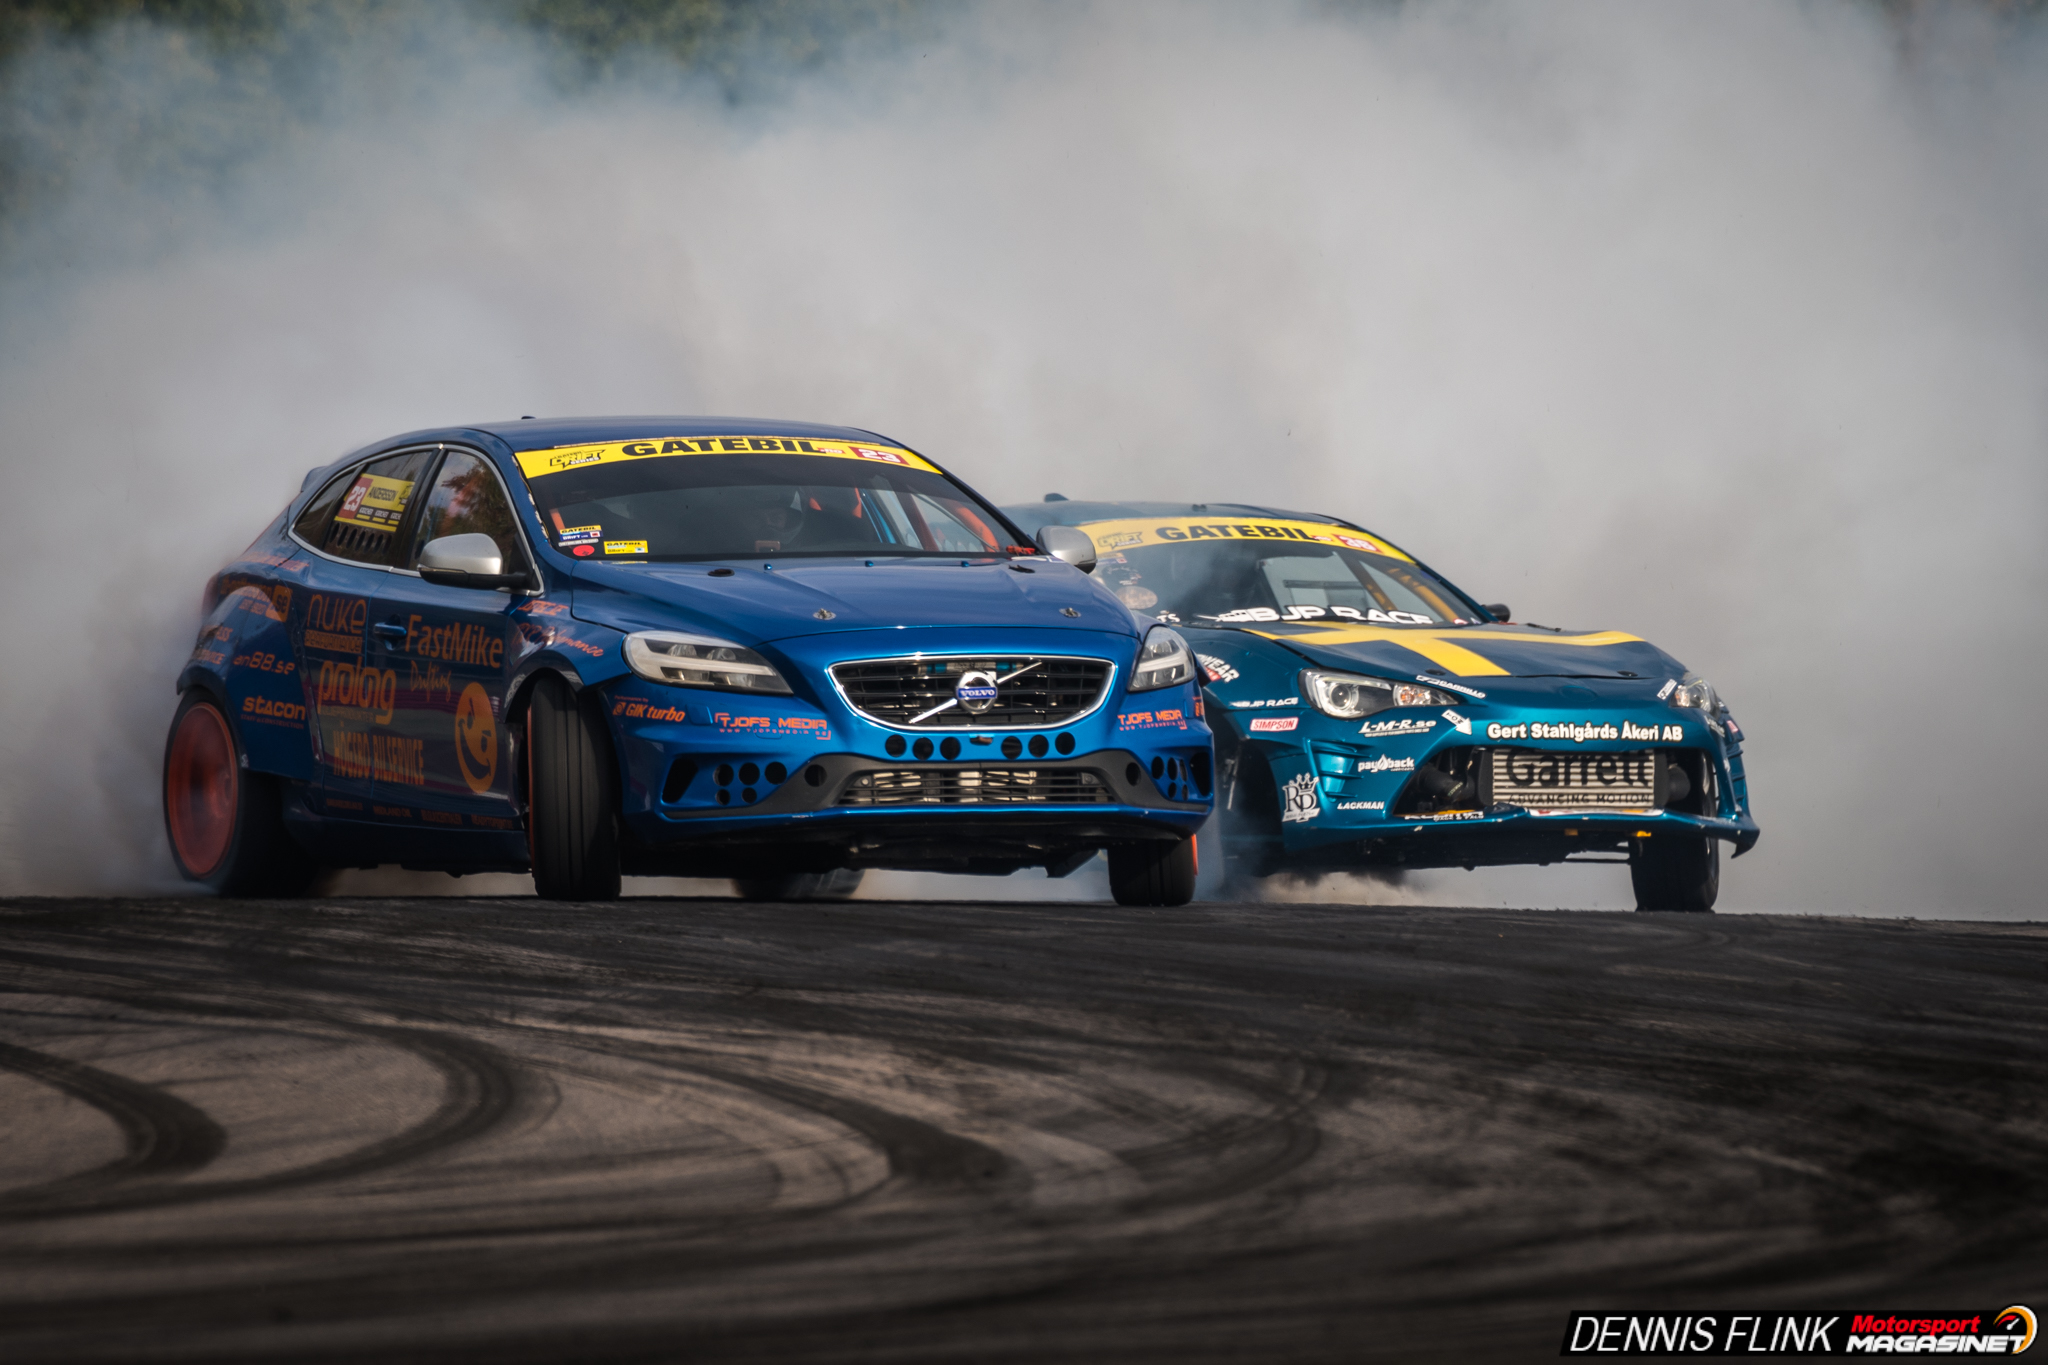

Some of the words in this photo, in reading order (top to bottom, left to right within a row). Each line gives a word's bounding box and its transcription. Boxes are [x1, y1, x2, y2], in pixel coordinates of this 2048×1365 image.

[622, 438, 827, 457] GATEBIL
[858, 449, 901, 463] 23
[343, 486, 367, 512] 23
[1155, 525, 1320, 541] GATEBIL
[306, 594, 367, 634] nuke
[1328, 606, 1434, 625] RACE
[405, 614, 504, 668] FastMike
[317, 656, 397, 725] prolog
[960, 689, 996, 697] VOLVO
[1266, 697, 1299, 707] RACE
[646, 706, 686, 722] turbo
[719, 716, 771, 728] TJOFS
[778, 717, 828, 730] MEDIA
[1117, 711, 1153, 726] TJOFS
[1155, 709, 1183, 722] MEDIA
[1253, 720, 1295, 730] SIMPSON
[1487, 722, 1528, 739] Gert
[1530, 720, 1619, 743] Stahlgårds
[1621, 720, 1660, 741] Åkeri
[1662, 726, 1684, 741] AB
[1505, 750, 1651, 787] Garrett
[1336, 801, 1385, 810] LACKMAN
